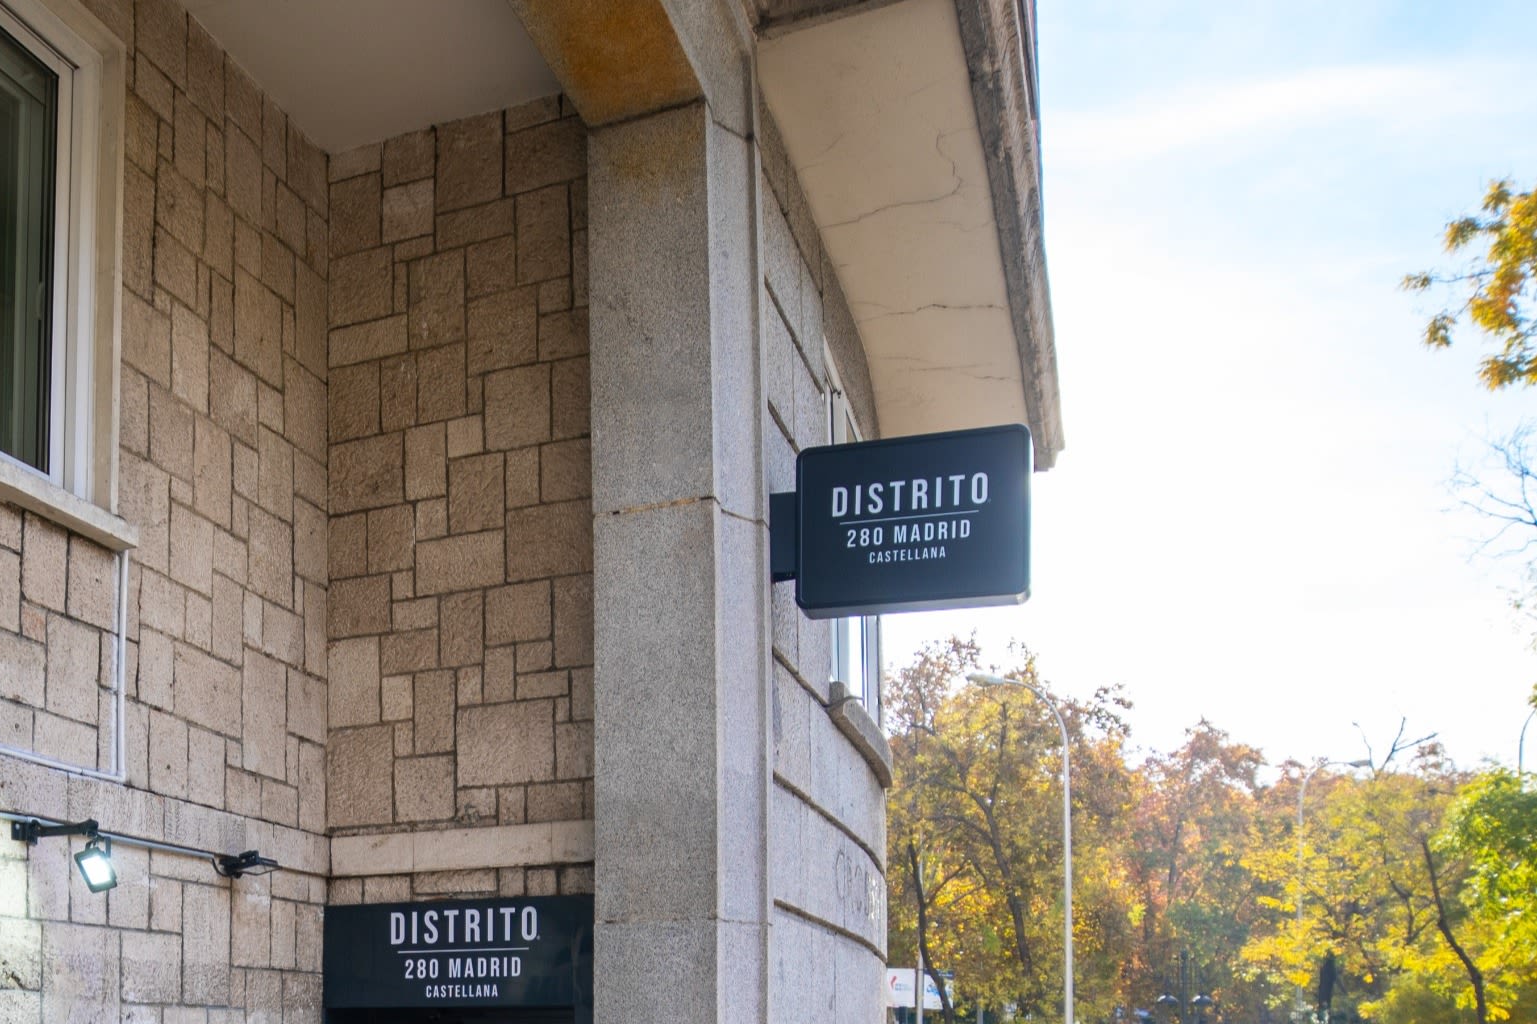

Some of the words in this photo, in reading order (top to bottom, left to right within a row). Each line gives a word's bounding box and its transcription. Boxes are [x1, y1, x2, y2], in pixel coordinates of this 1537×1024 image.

[832, 472, 989, 517] DISTRITO
[847, 527, 883, 548] 280
[894, 519, 971, 544] MADRID
[869, 546, 946, 563] CASTELLANA
[390, 906, 538, 945] DISTRITO
[404, 959, 439, 979] 280
[449, 957, 521, 978] MADRID
[426, 984, 498, 998] CASTELLANA
